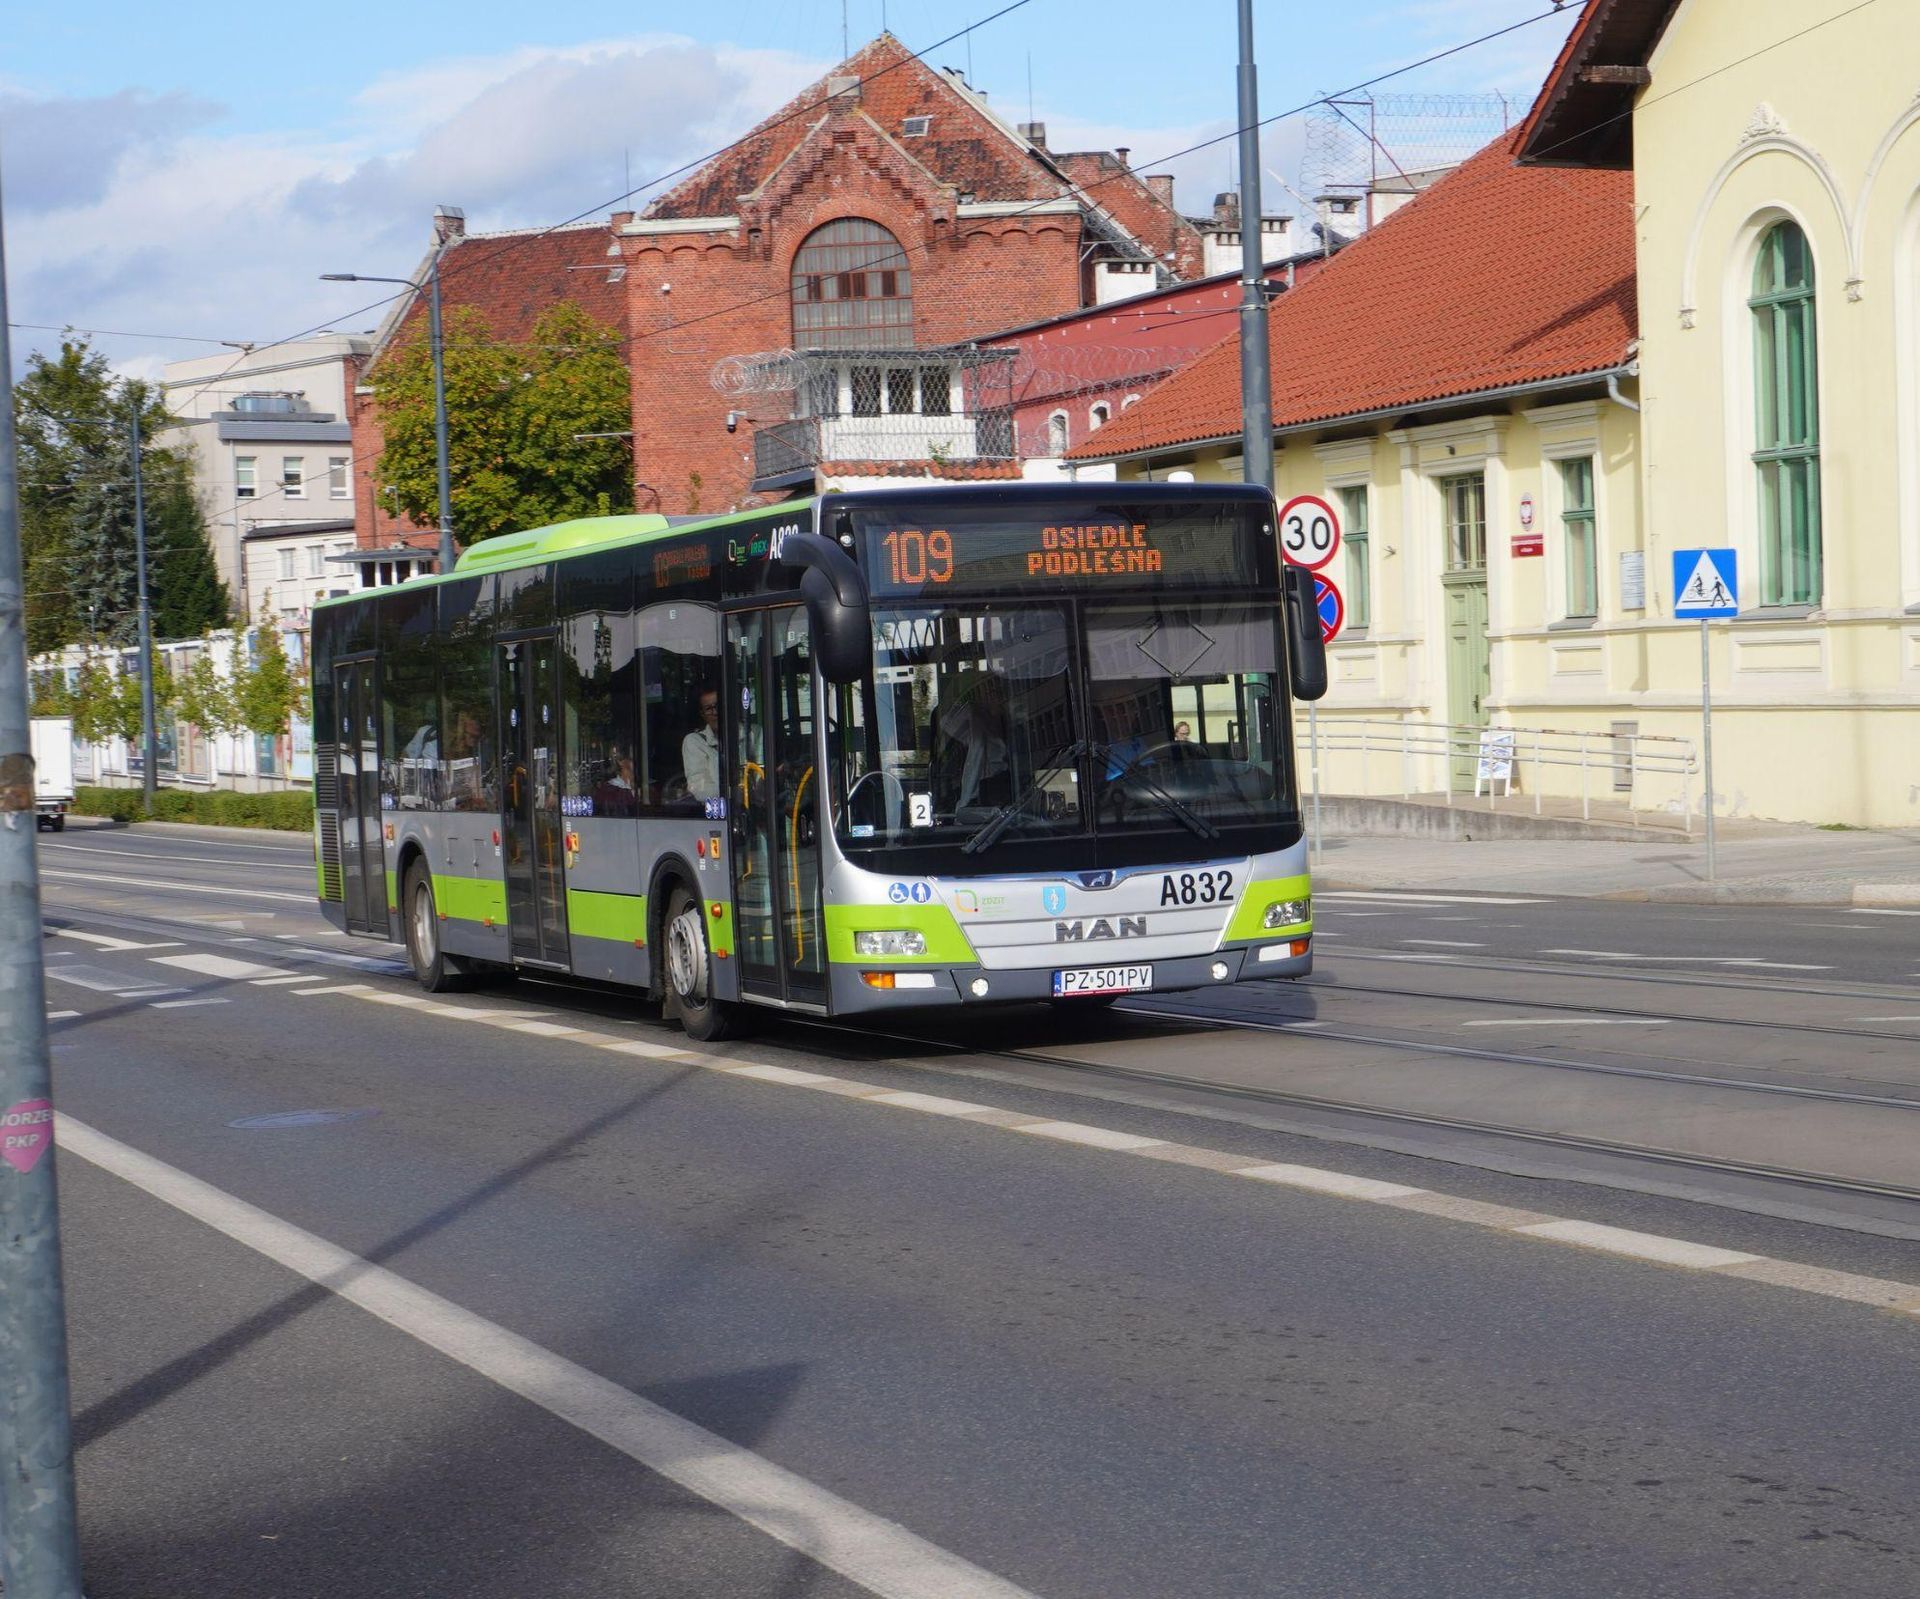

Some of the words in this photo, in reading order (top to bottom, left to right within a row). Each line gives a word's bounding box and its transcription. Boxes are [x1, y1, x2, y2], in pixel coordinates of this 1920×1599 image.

[1042, 524, 1146, 550] OSIEDLE
[1286, 516, 1330, 550] 30
[881, 530, 954, 584] 109
[916, 804, 926, 819] 2
[1160, 870, 1234, 906] A832
[1055, 916, 1148, 942] MAN
[1064, 972, 1089, 990] PZ
[1097, 968, 1149, 988] 501PV
[5, 1134, 39, 1149] PKP
